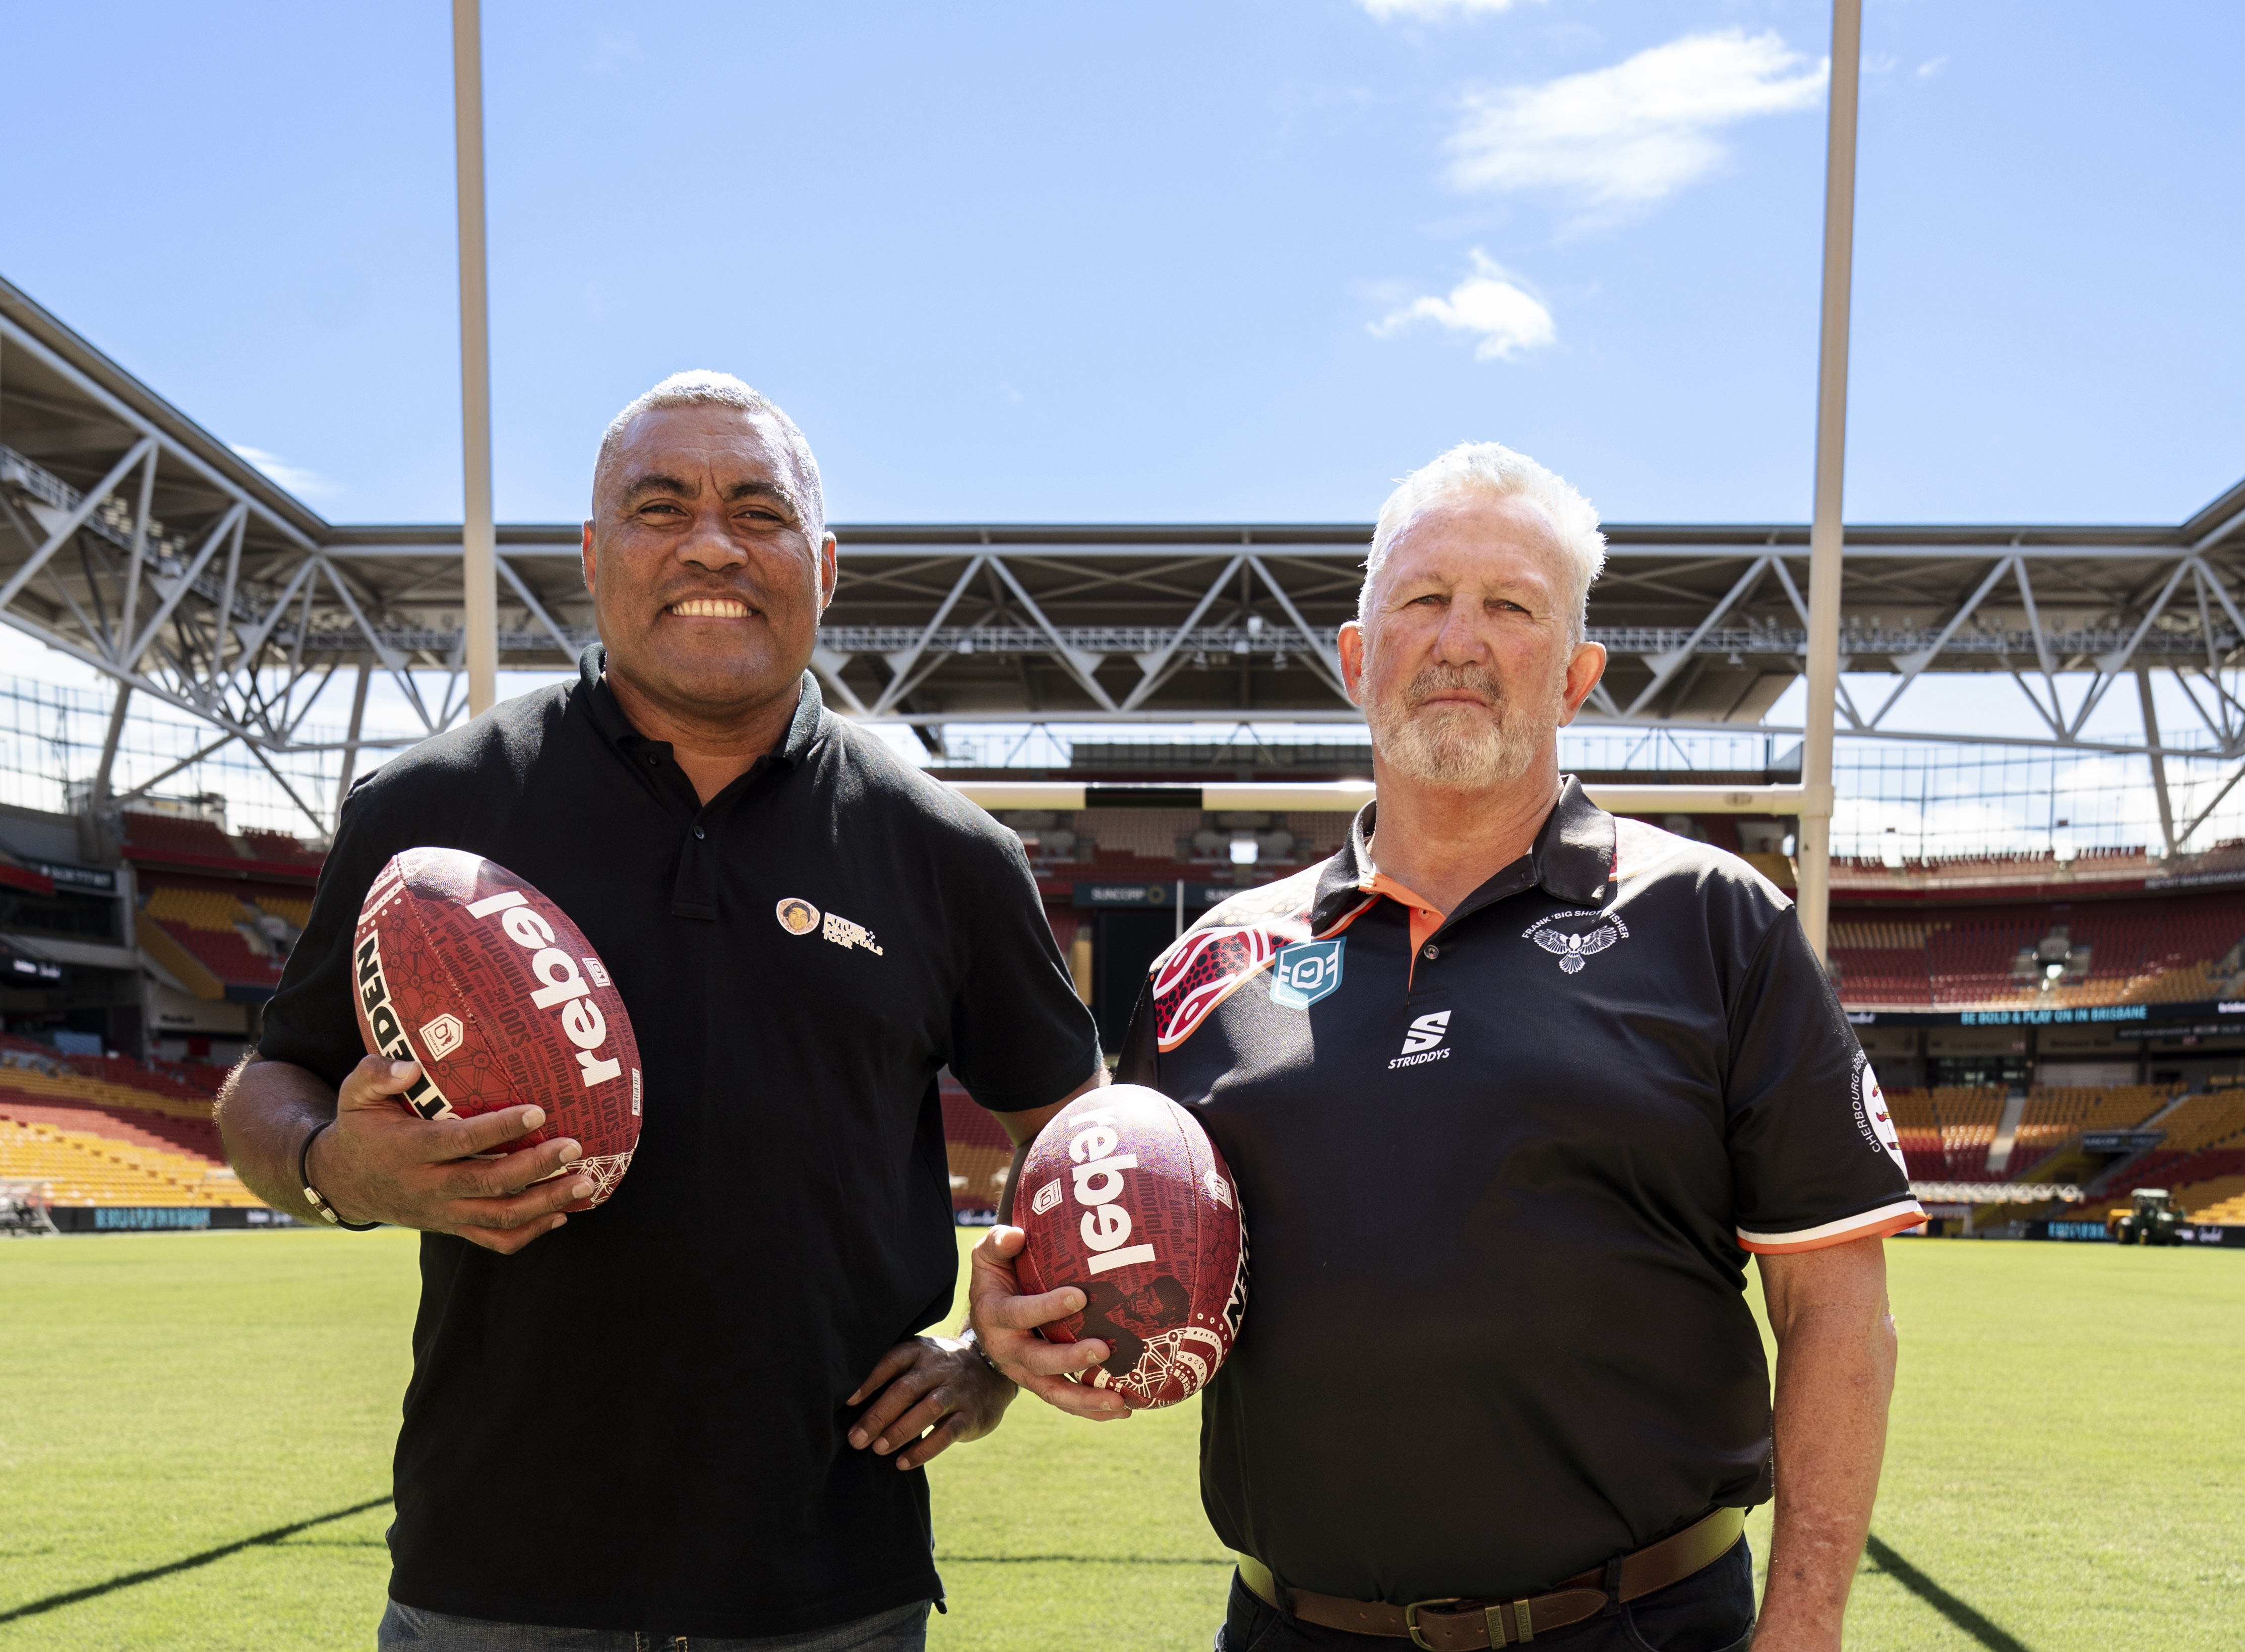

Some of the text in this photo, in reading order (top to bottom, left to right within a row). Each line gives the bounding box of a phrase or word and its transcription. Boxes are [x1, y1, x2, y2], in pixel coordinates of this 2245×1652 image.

[823, 930, 853, 949] TOUR
[824, 923, 883, 956] IMMORTALS
[825, 915, 867, 939] FUTURE
[1522, 916, 1551, 938] FRANK
[1607, 911, 1629, 939] FISHER
[453, 942, 483, 972] Artie
[467, 925, 533, 1002] Immortal
[466, 891, 621, 1087] rebel
[492, 987, 513, 1008] FOG
[496, 1007, 532, 1049] SOO
[518, 1002, 544, 1039] Legend
[1961, 1005, 2148, 1025] BE BOLD & PLAY ON IN BRISBANE
[425, 1030, 442, 1053] MAROONS
[1388, 1048, 1450, 1069] STRUDDYS
[503, 1051, 530, 1086] Artie
[519, 1046, 542, 1088] Aboriginal
[537, 1035, 579, 1132] Legend Wiradjuri
[577, 1093, 590, 1116] Kabi
[599, 1095, 621, 1135] SOO
[1851, 1073, 1881, 1152] CHERBOURG
[582, 1120, 594, 1142] Kabi
[1068, 1107, 1157, 1275] rebel
[1135, 1168, 1167, 1235] mmortal
[1169, 1198, 1186, 1227] Artie
[1050, 1208, 1070, 1258] Wiradjuri
[1169, 1227, 1187, 1253] Kabi
[1490, 1611, 1503, 1646] RINGERS
[1518, 1605, 1530, 1641] WESTERN
